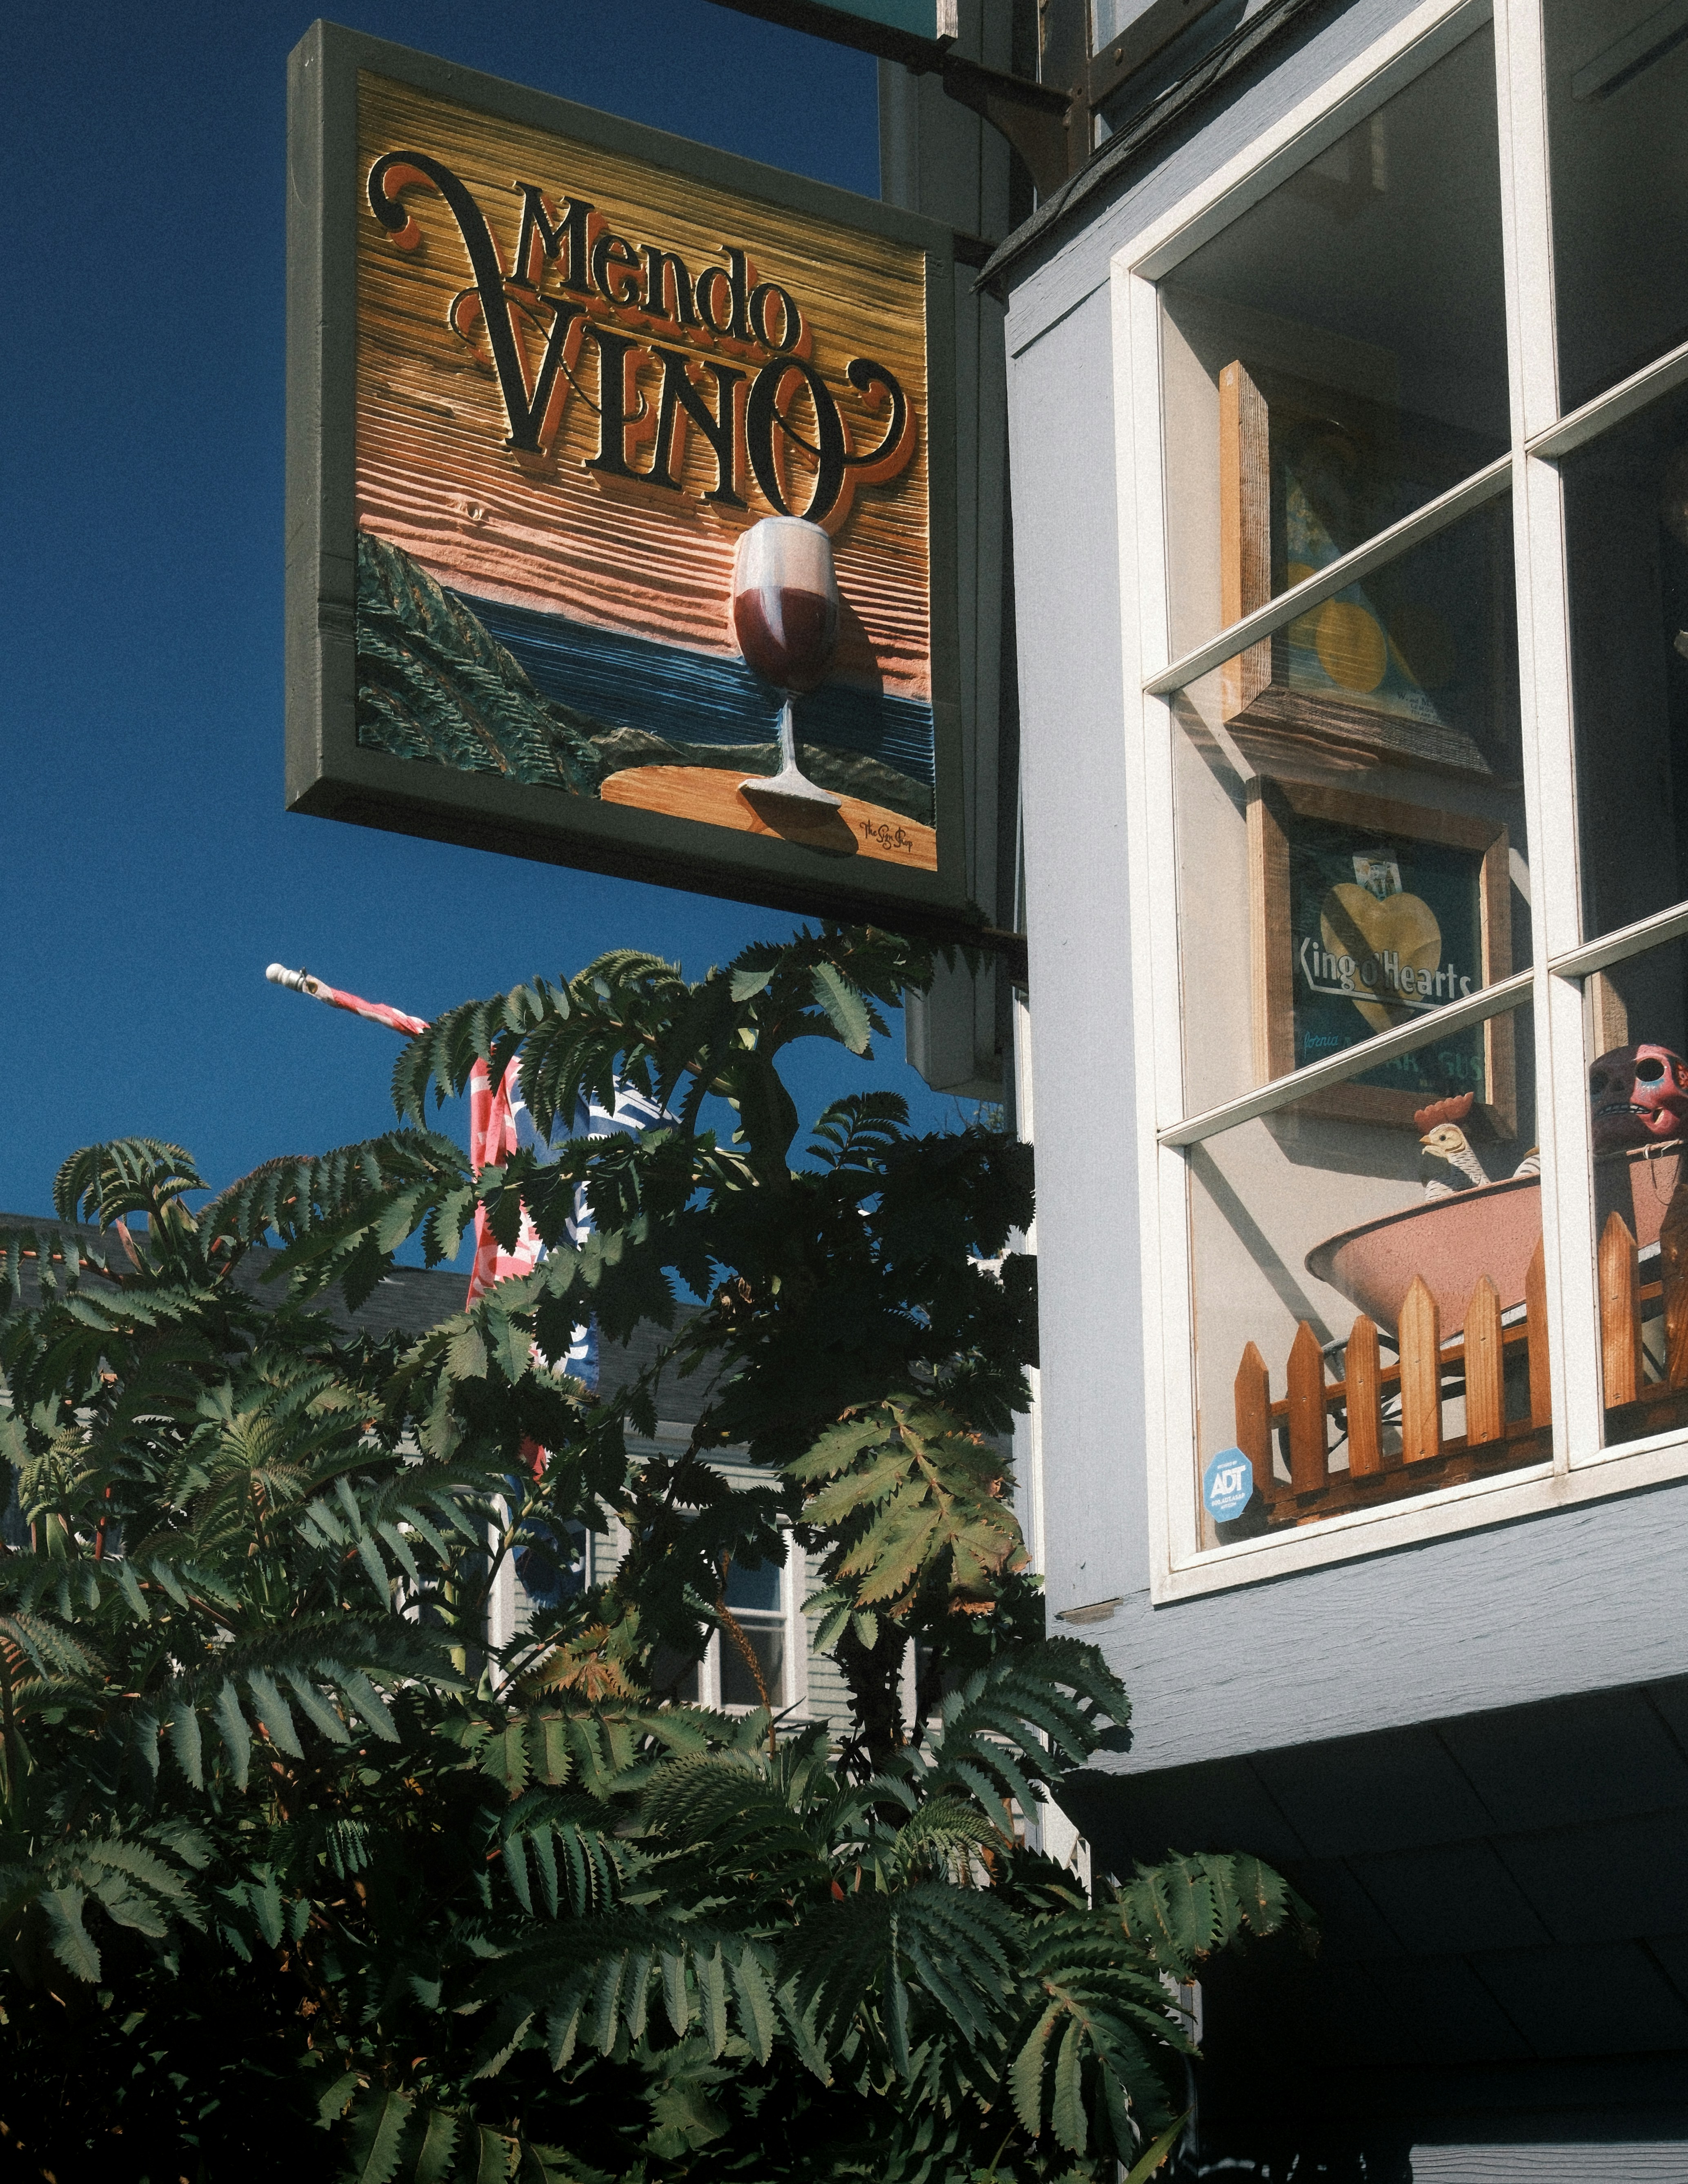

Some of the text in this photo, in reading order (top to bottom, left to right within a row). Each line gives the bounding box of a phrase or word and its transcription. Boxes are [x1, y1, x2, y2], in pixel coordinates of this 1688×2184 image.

[505, 180, 799, 353] Mendo
[367, 151, 907, 521] VINO
[859, 819, 913, 853] The Sign Shop
[1210, 1464, 1246, 1498] ADT
